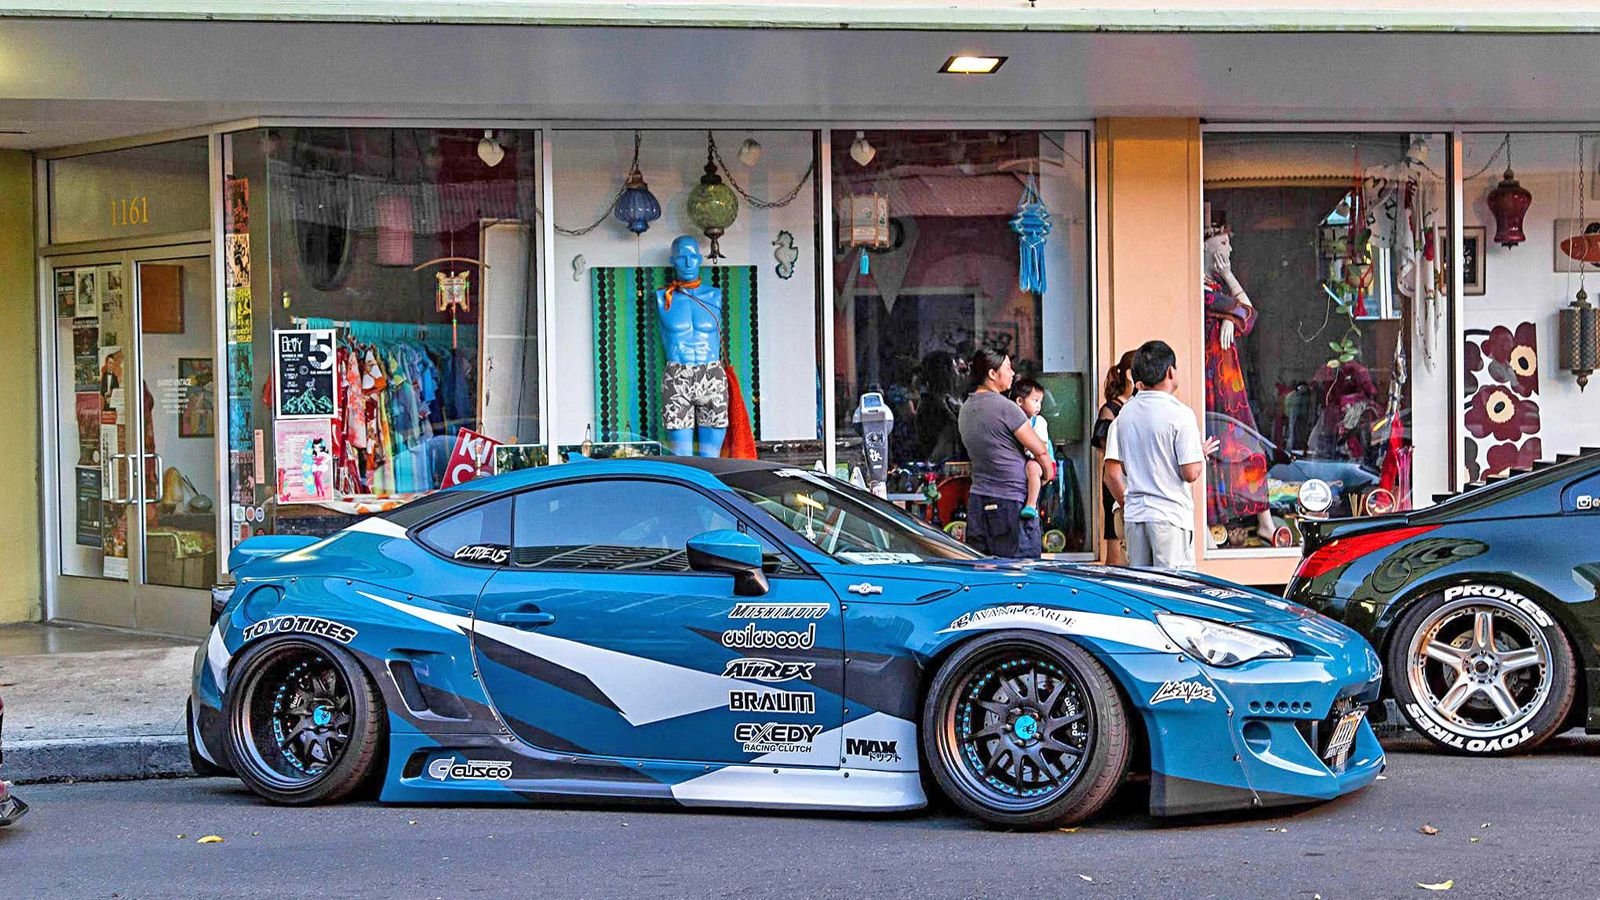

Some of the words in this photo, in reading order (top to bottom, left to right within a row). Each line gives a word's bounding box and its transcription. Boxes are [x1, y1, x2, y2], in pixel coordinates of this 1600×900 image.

[111, 197, 149, 226] 1161
[308, 332, 333, 370] 5
[729, 604, 829, 618] MISHIMOTO
[971, 605, 1023, 623] AVANT
[1024, 607, 1078, 629] GARDE
[1444, 585, 1554, 627] PROXES
[722, 623, 815, 648] wilwood
[729, 691, 815, 713] BRAUM
[735, 723, 823, 743] EXEDY
[744, 743, 776, 752] RACING
[777, 744, 812, 753] CLUTCH
[846, 738, 898, 756] MAX
